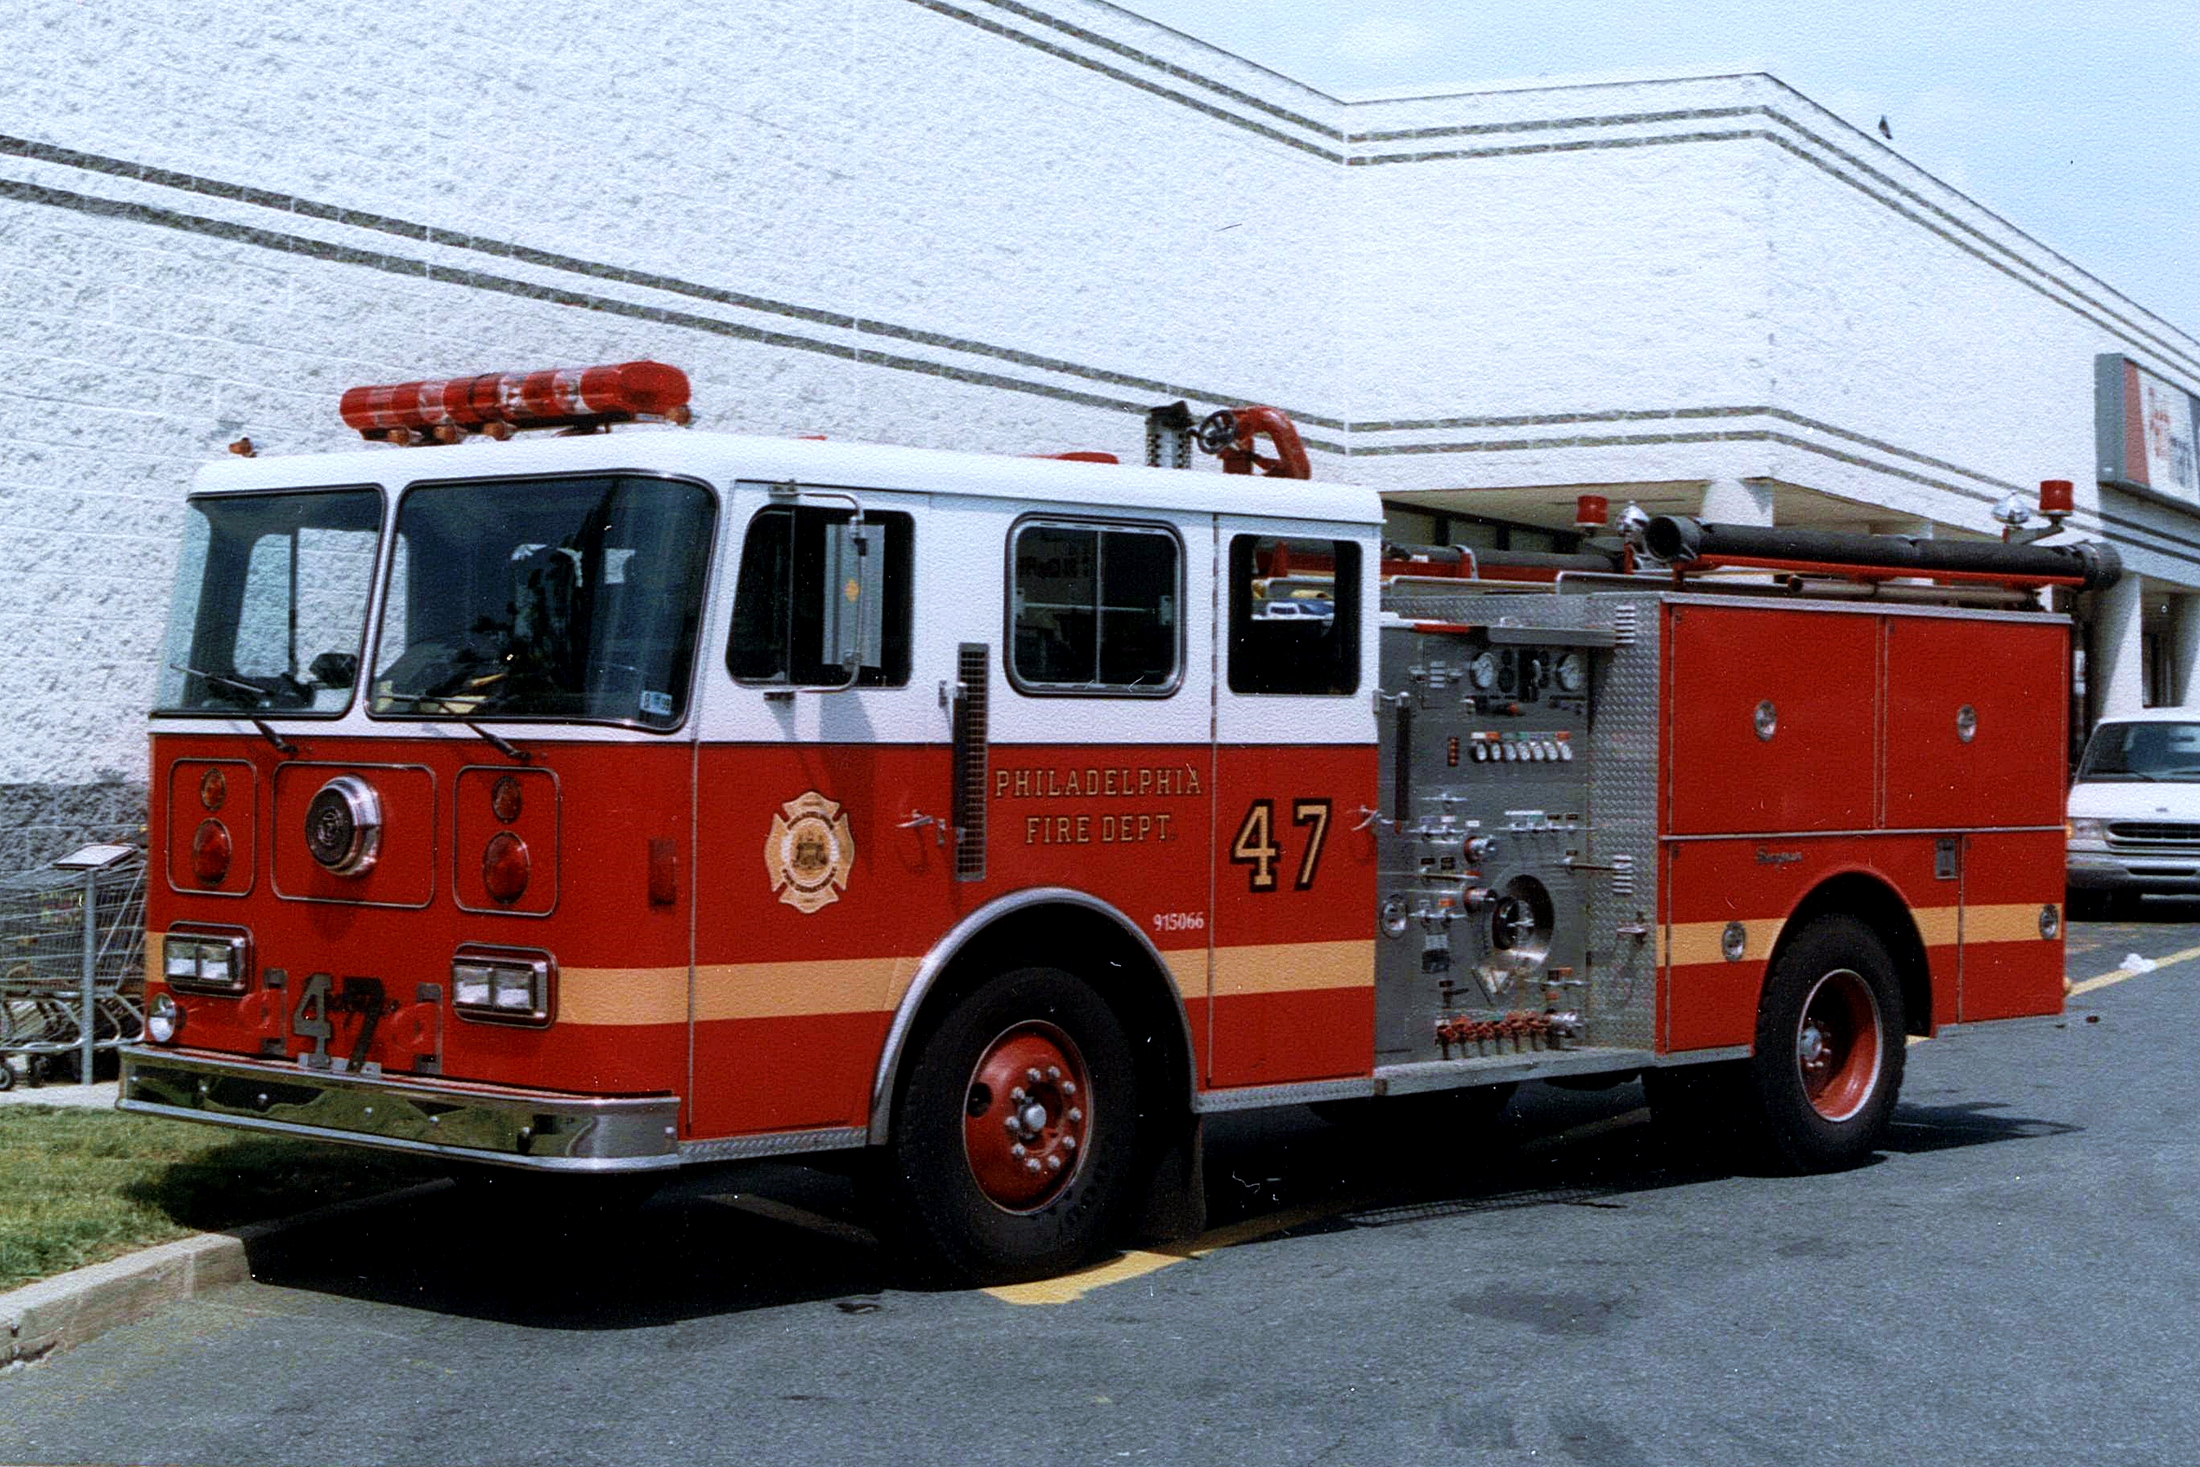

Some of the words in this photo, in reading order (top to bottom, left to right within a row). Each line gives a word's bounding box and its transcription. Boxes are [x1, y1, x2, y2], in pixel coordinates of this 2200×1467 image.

[995, 769, 1201, 797] PHILADELPHIA
[1025, 816, 1090, 844] FIRE
[1230, 799, 1333, 892] 47
[1153, 912, 1204, 932] 915066
[294, 973, 384, 1072] 47
